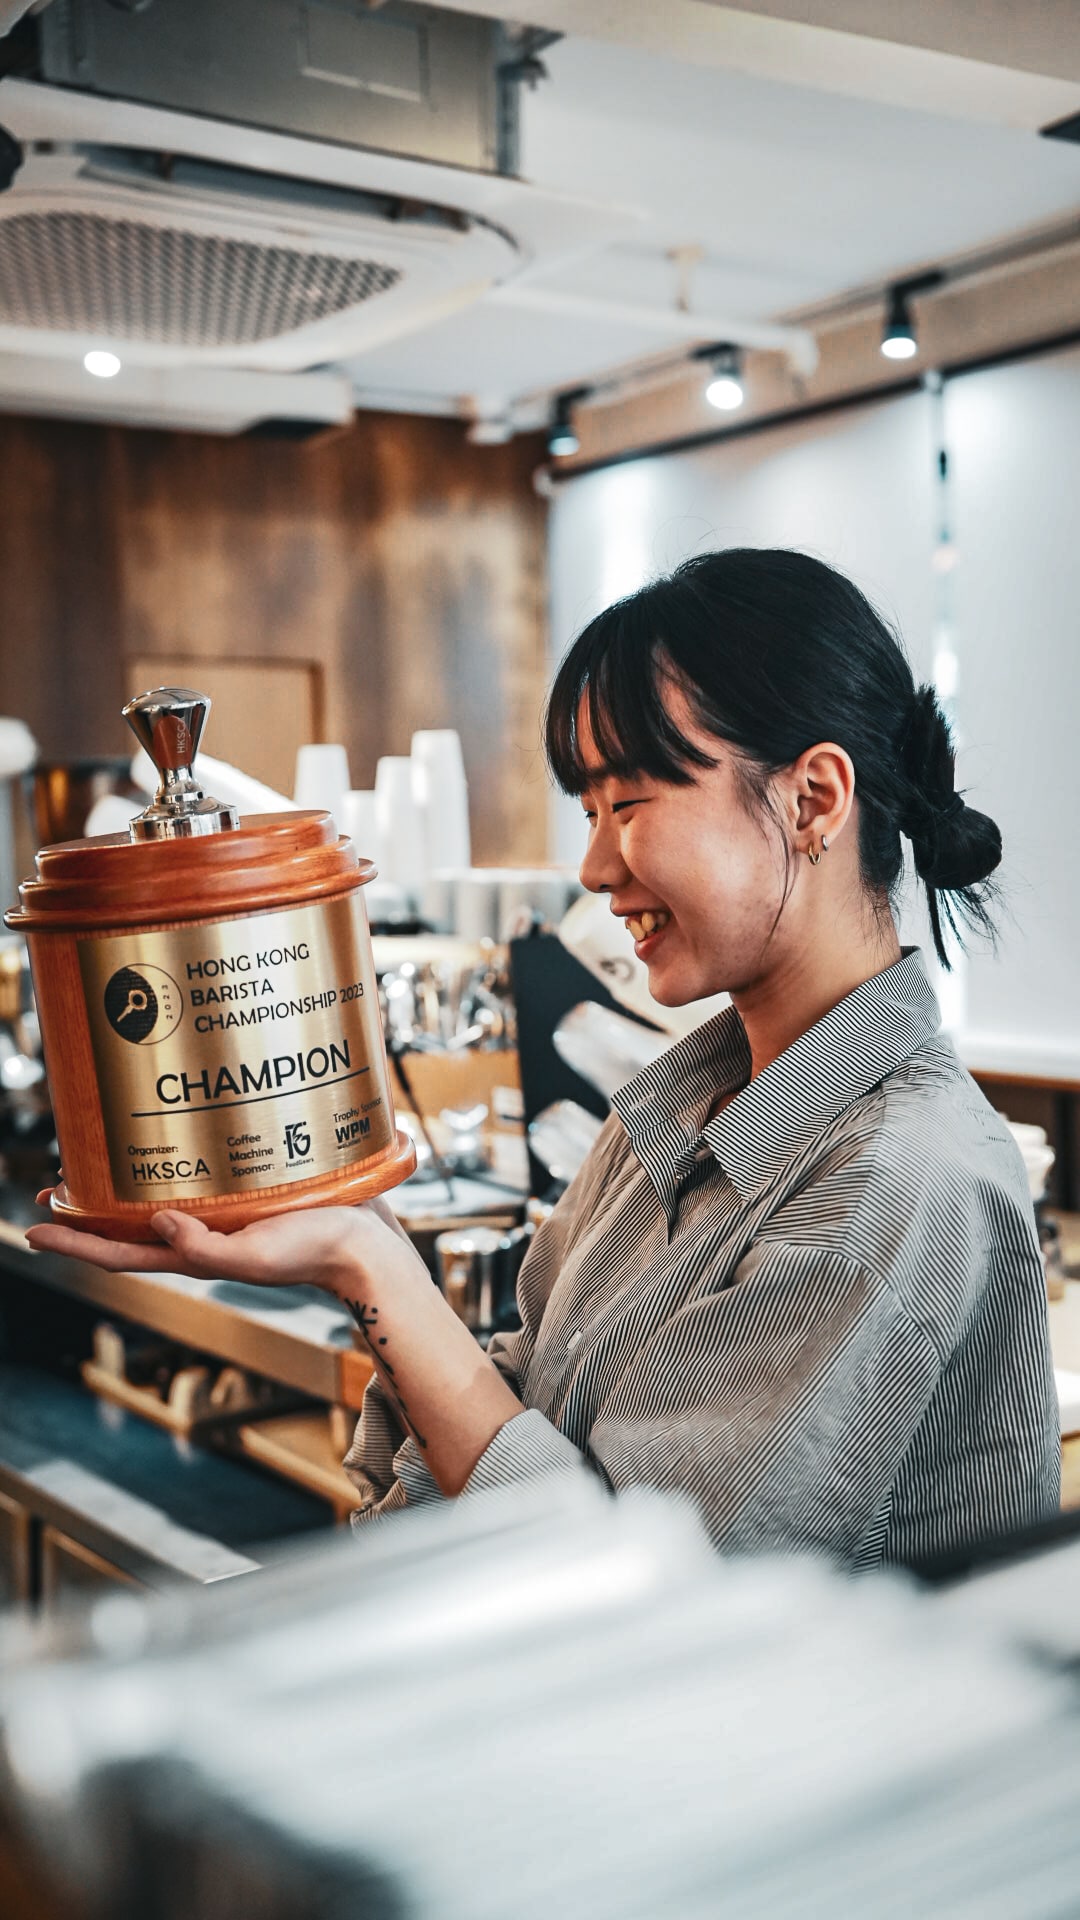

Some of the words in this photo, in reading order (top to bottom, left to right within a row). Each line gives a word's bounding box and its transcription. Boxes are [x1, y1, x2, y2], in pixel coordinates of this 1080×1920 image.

[186, 955, 251, 980] HONG
[256, 943, 310, 969] KONG
[162, 984, 174, 1020] 2023
[190, 978, 275, 1007] BARISTA
[194, 990, 337, 1033] CHAMPIONSHIP
[339, 982, 364, 1004] 2023
[156, 1039, 351, 1104] CHAMPION
[333, 1107, 360, 1123] Trophy
[226, 1134, 262, 1147] Coffee
[335, 1116, 371, 1144] WPM
[128, 1145, 179, 1157] Organizer:
[229, 1147, 274, 1162] Machine
[131, 1158, 211, 1180] HKSCA
[231, 1163, 276, 1178] Sponsor:
